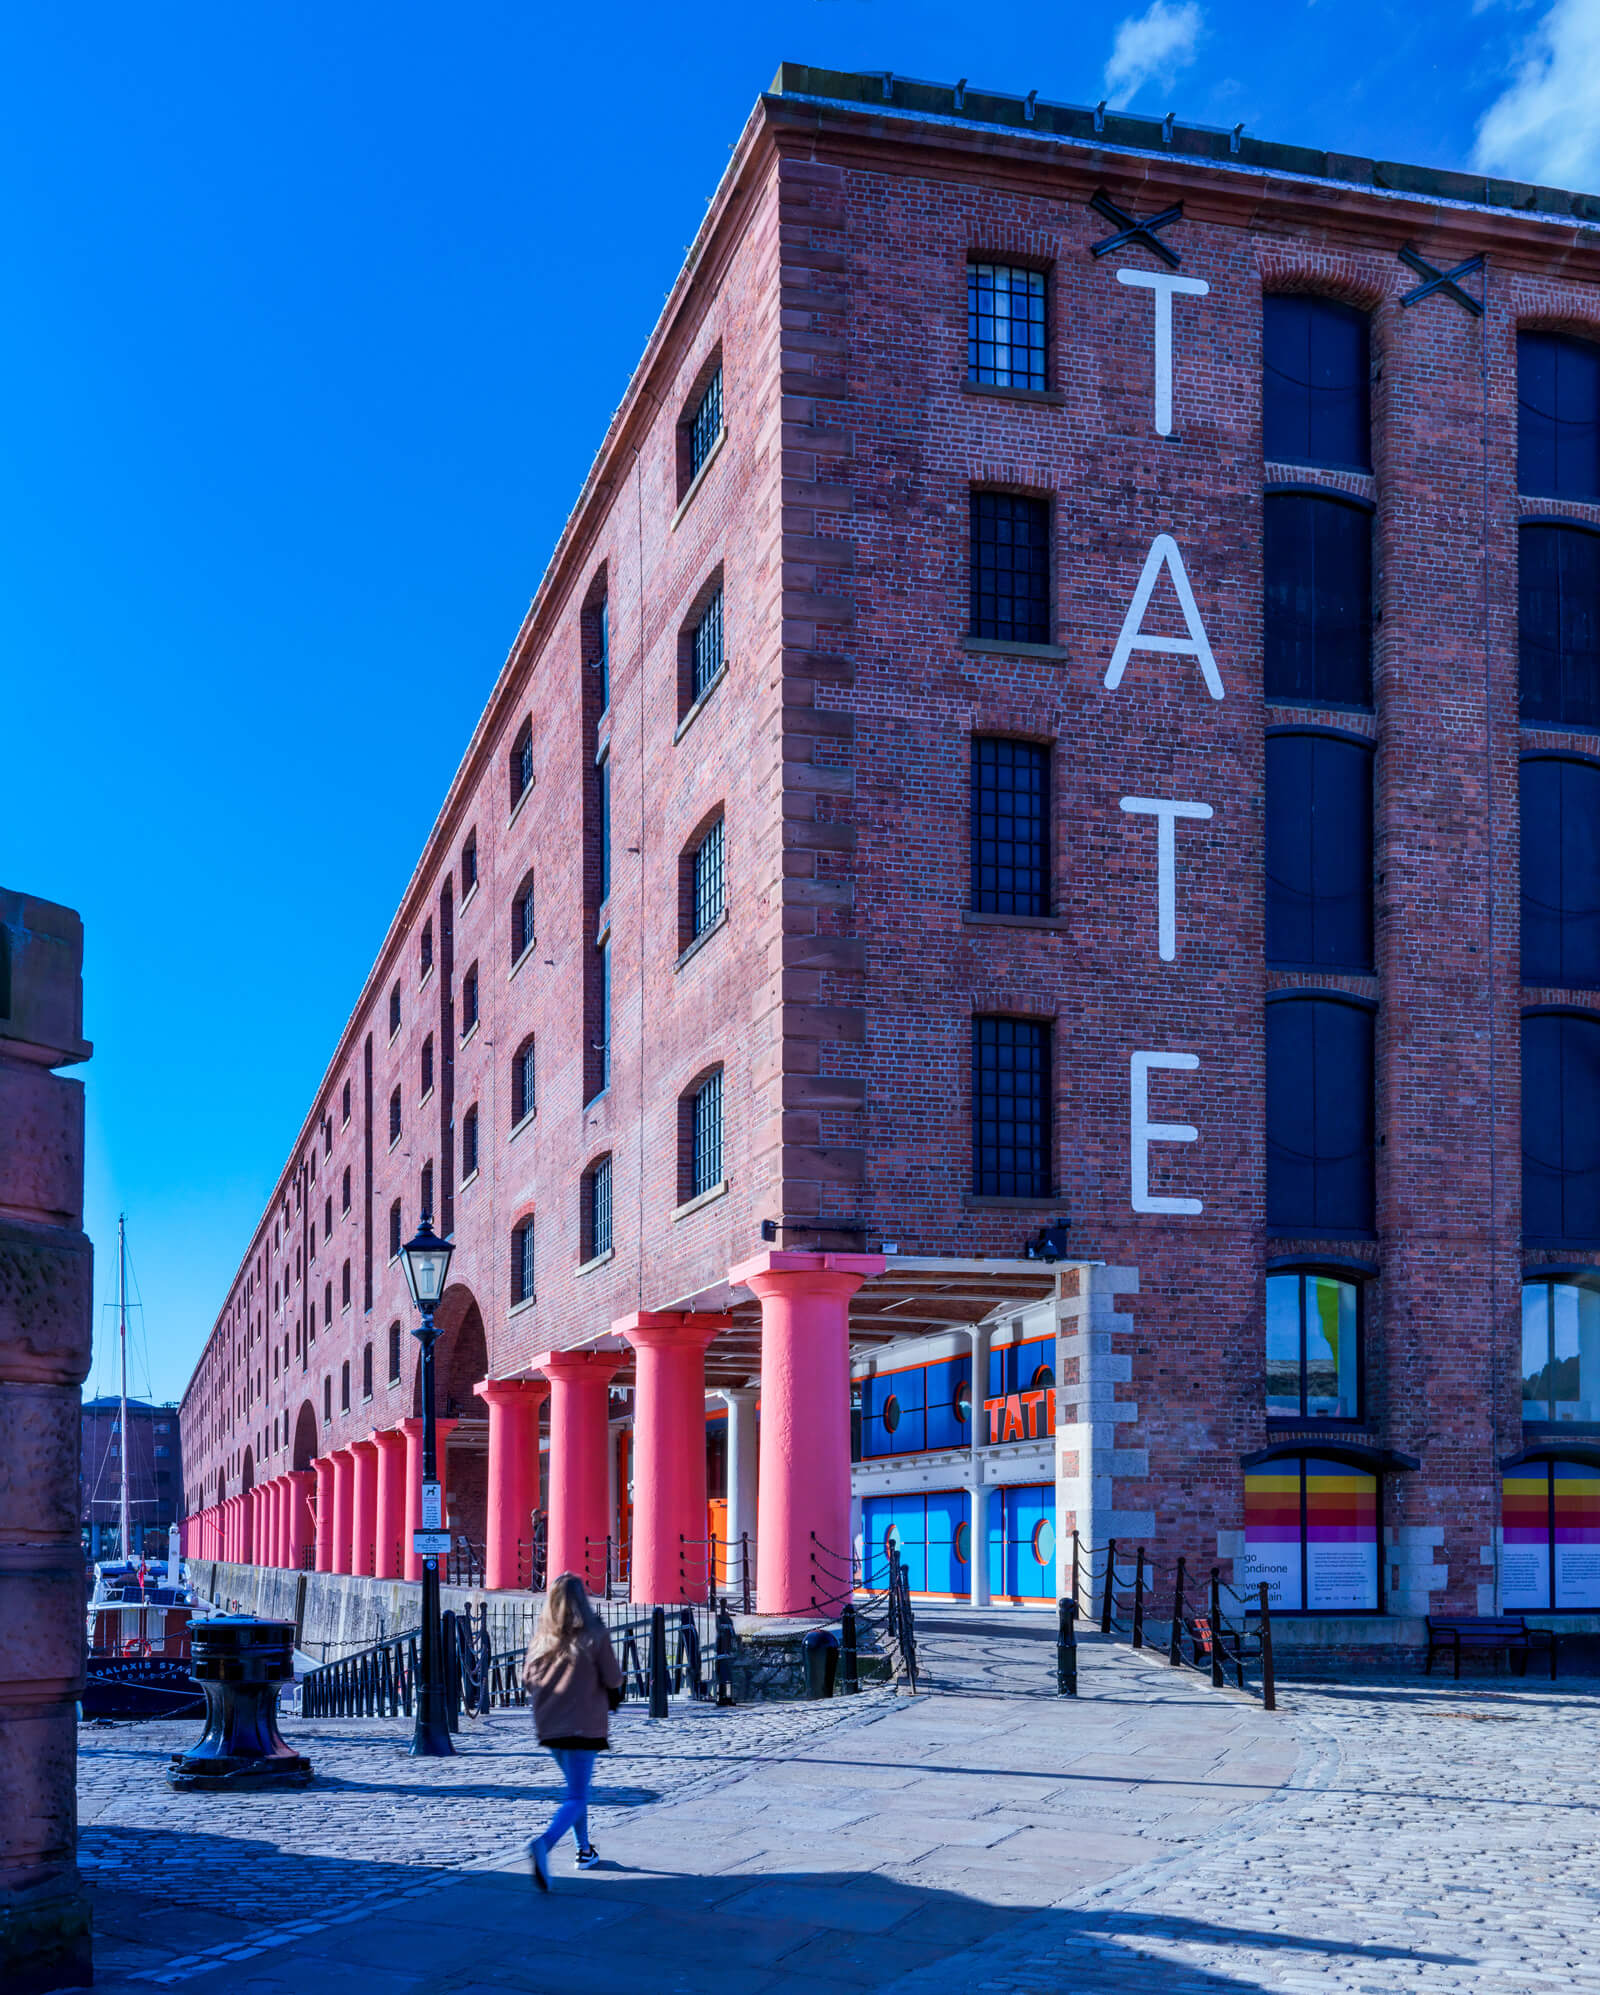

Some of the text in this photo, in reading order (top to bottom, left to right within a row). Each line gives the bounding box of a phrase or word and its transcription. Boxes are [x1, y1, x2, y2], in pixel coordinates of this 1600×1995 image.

[1103, 267, 1226, 1214] TATE
[1243, 1554, 1257, 1564] go
[1244, 1563, 1288, 1573] ondinone
